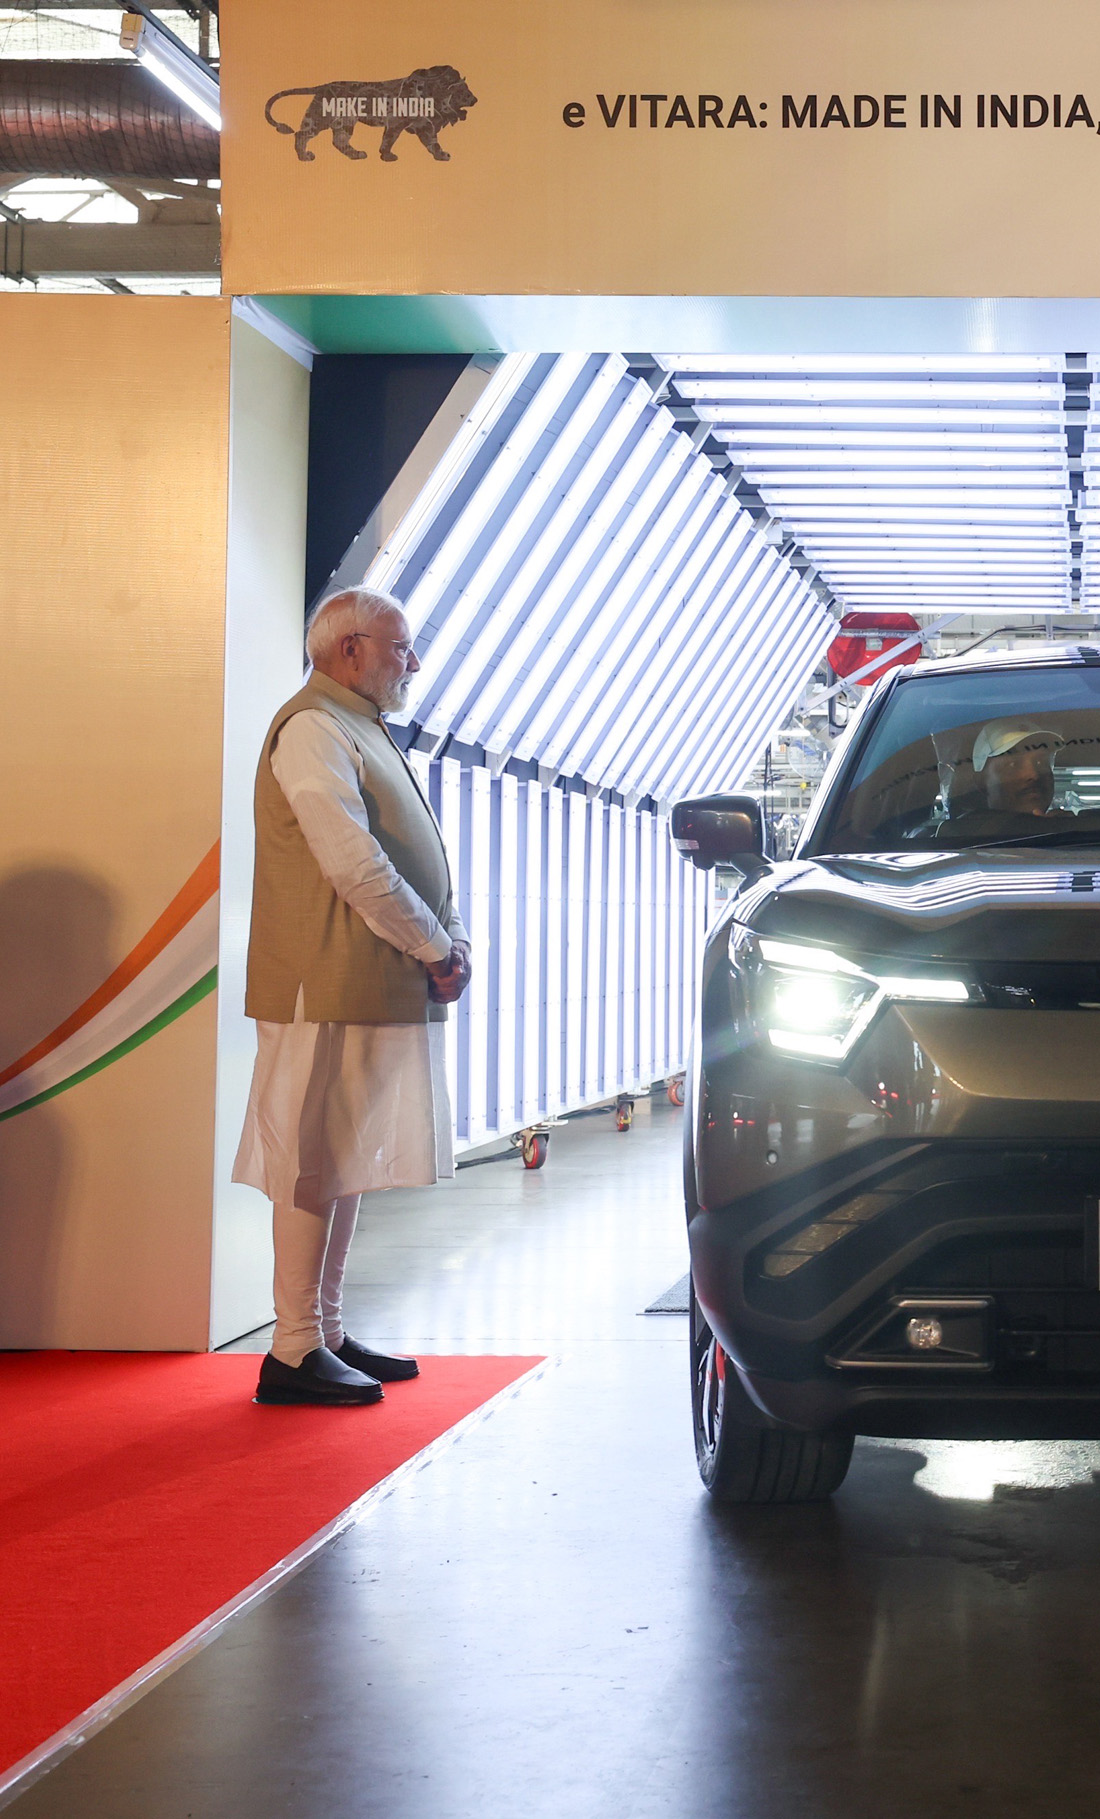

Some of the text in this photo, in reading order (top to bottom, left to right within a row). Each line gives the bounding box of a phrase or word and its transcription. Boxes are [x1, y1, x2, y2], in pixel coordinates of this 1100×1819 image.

[321, 97, 435, 117] MAKE IN INDIA
[562, 102, 587, 128] e
[595, 94, 768, 128] VITARA:
[782, 94, 907, 128] MADE
[920, 95, 961, 128] IN
